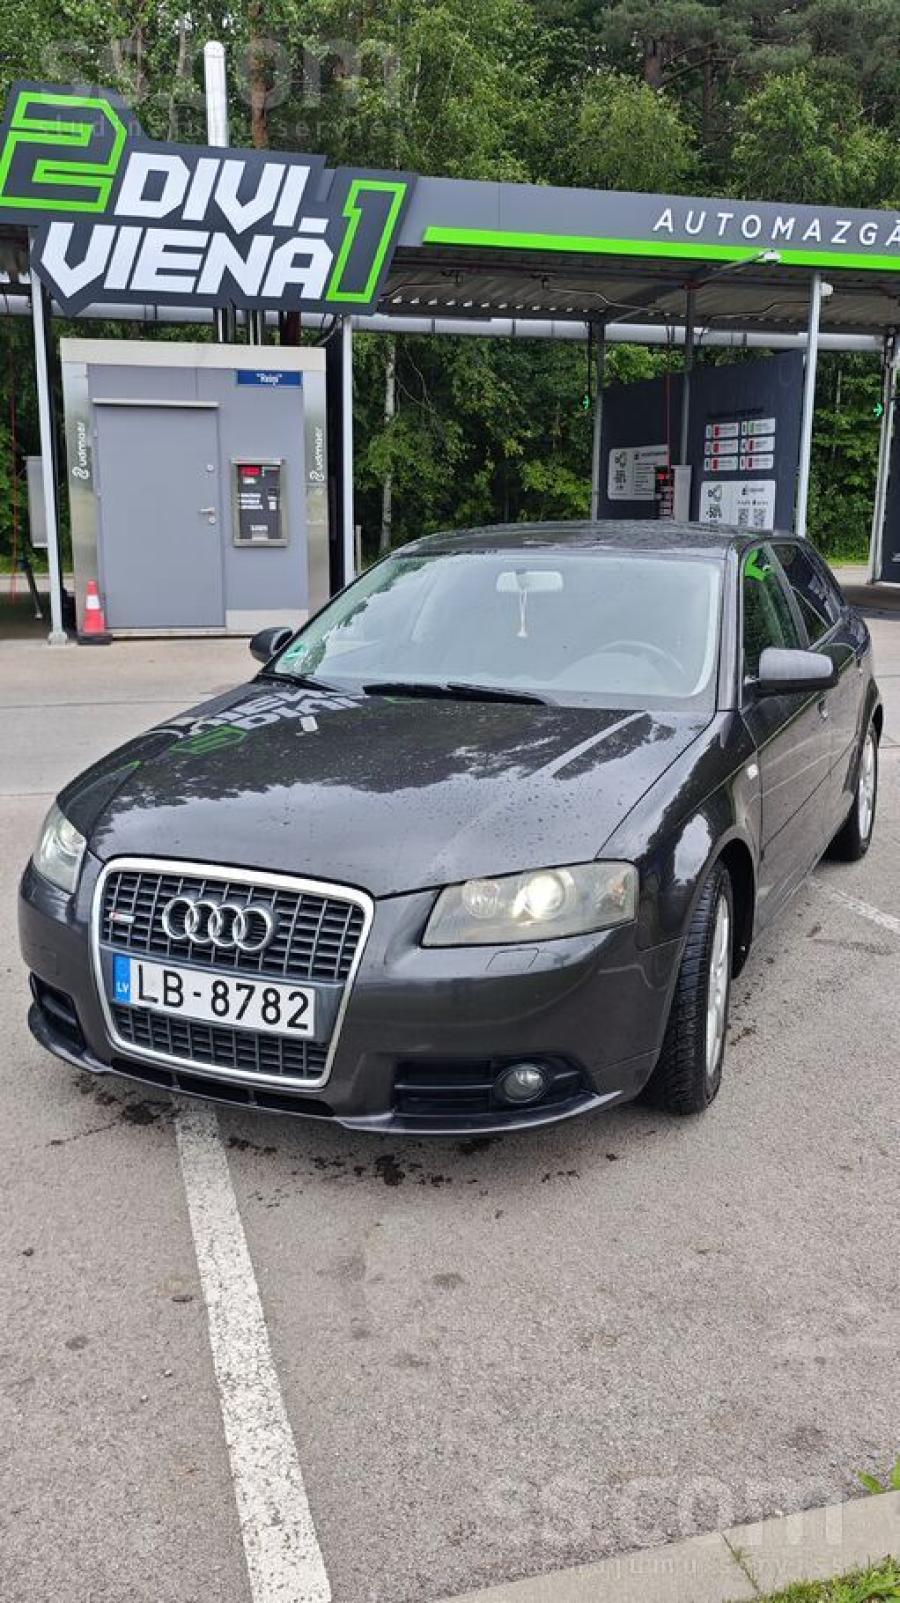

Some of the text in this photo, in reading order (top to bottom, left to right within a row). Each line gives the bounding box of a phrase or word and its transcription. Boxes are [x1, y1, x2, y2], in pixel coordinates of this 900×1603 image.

[0, 91, 312, 234] 2 DIVI
[325, 180, 407, 303] 1
[117, 964, 309, 1031] LV LB-8782
